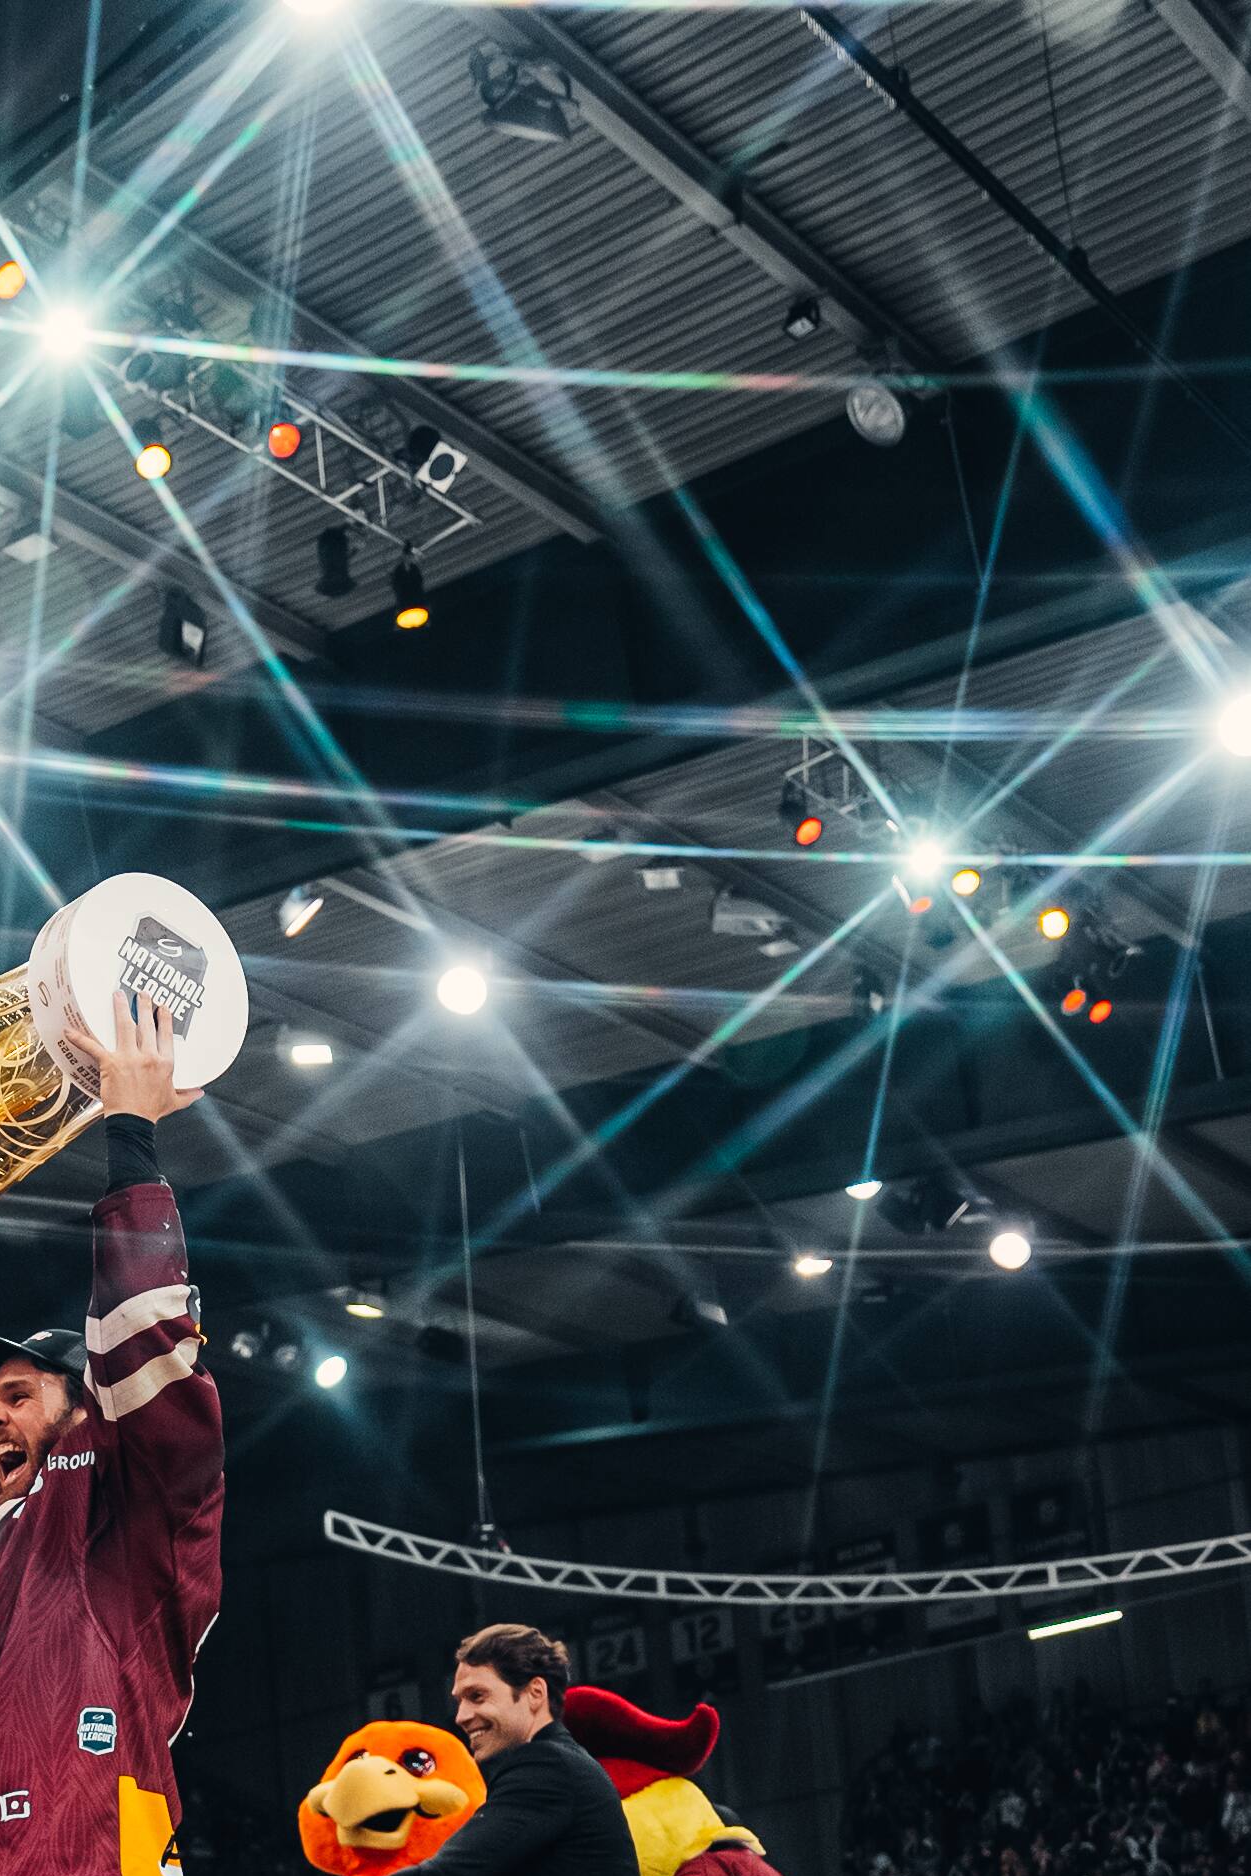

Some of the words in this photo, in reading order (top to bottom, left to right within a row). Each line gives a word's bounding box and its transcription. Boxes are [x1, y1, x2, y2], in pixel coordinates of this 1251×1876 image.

[119, 938, 204, 1006] NATIONAL
[121, 965, 191, 1022] LEAGUE
[683, 1615, 721, 1652] 12
[596, 1634, 637, 1673] 24
[78, 1722, 116, 1734] NATIONAL
[82, 1732, 112, 1743] LEAGUE
